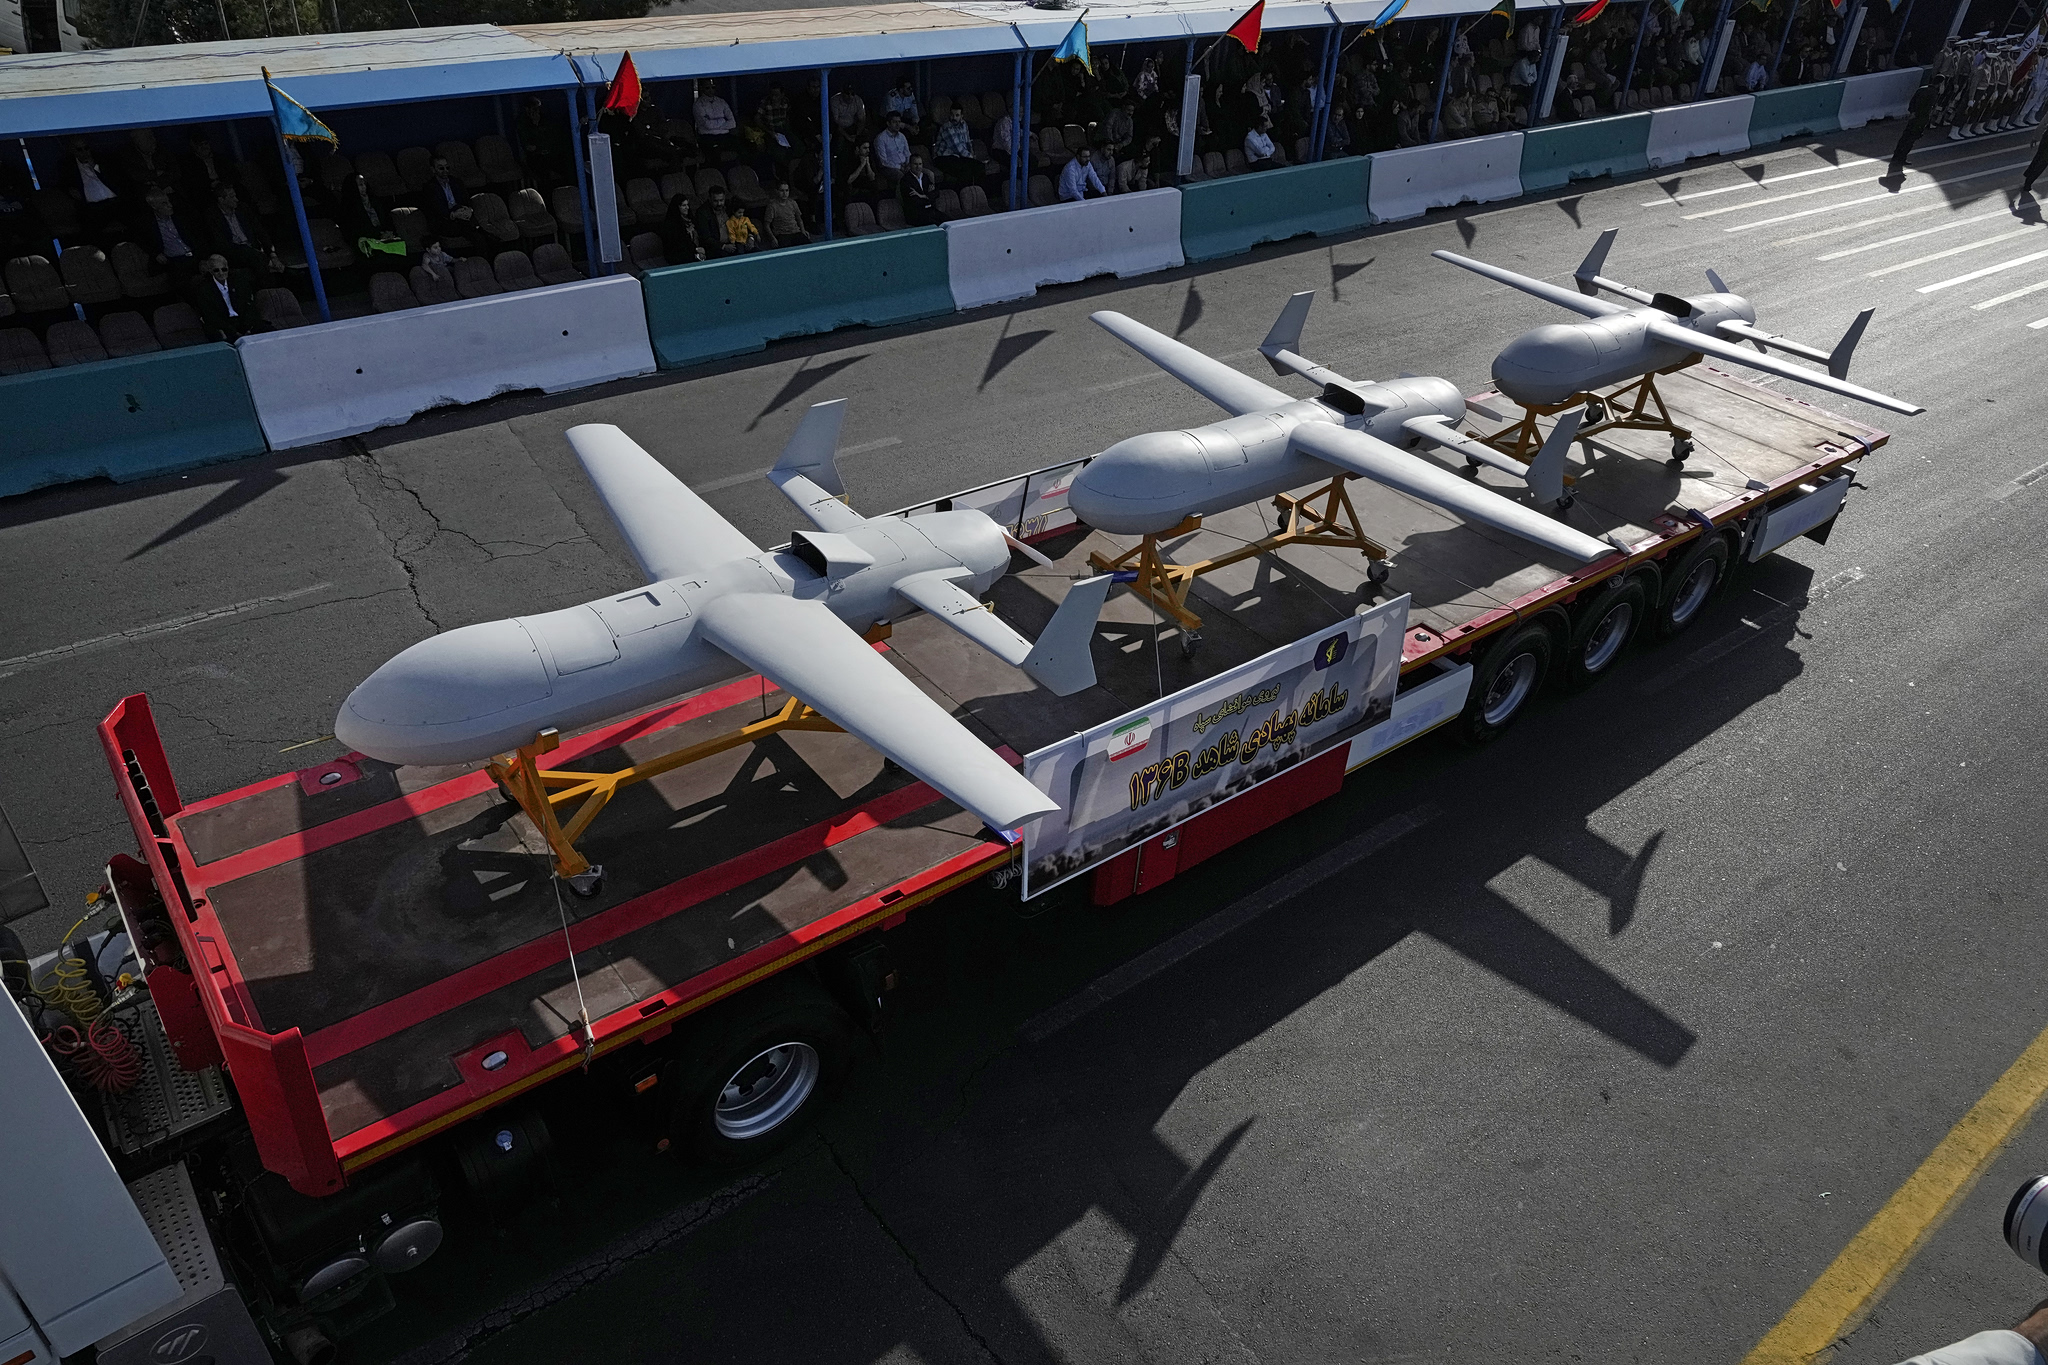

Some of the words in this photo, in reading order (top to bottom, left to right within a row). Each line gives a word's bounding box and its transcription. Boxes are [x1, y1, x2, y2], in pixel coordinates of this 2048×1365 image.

[1252, 682, 1281, 706] نیروی
[1299, 682, 1348, 726] سامانه
[1193, 713, 1212, 734] سپاه
[1240, 710, 1298, 764] پهپادی
[1193, 731, 1240, 779] شاهد
[1130, 751, 1191, 810] ۱۳۶B
